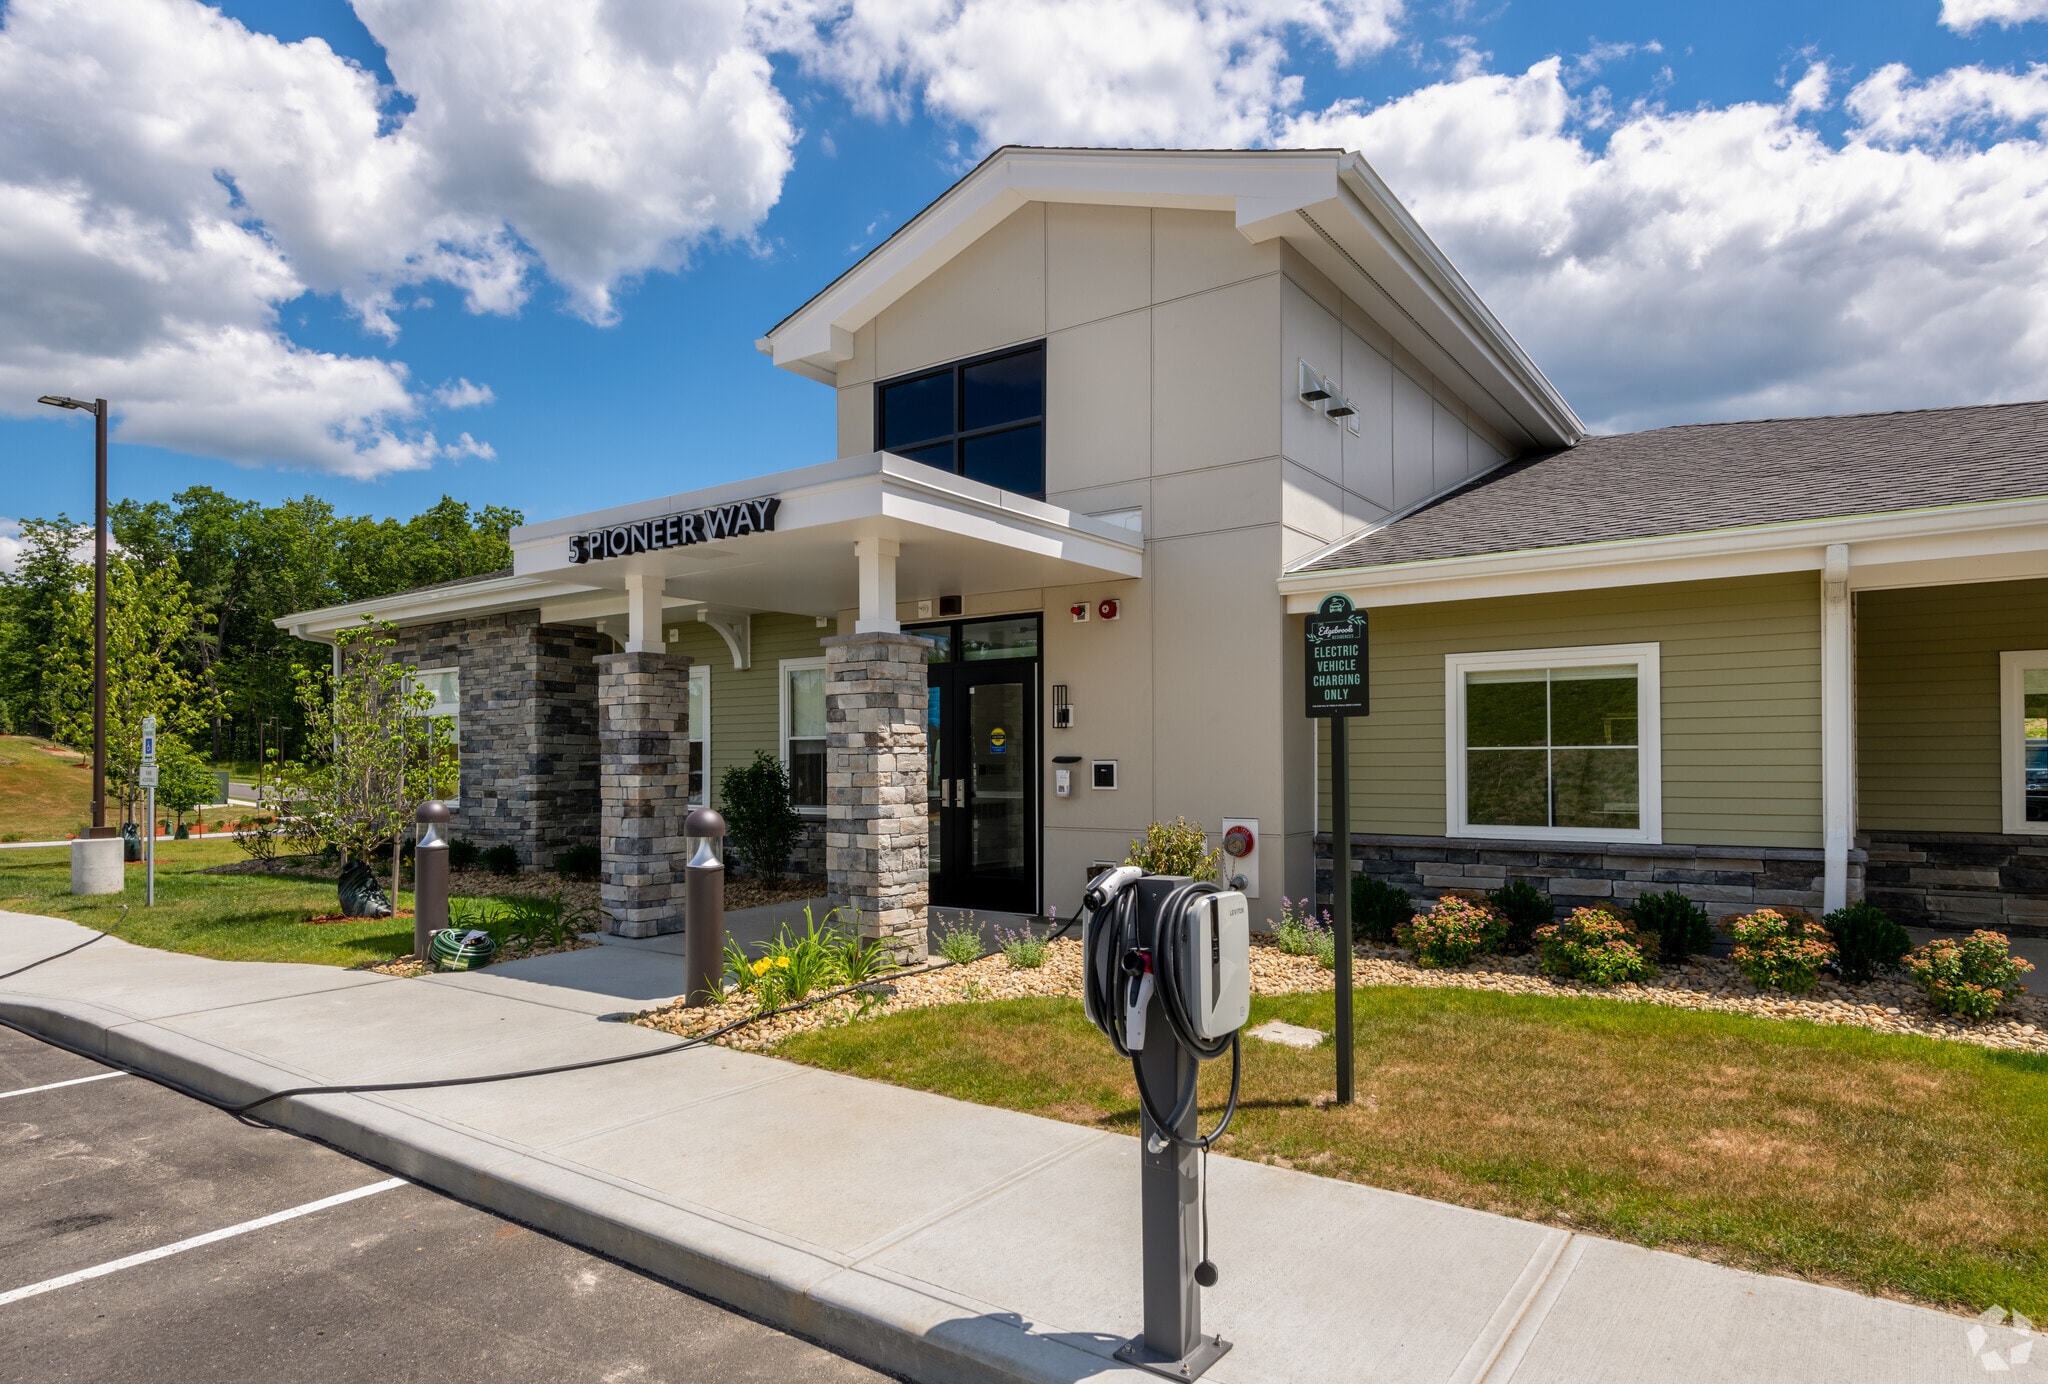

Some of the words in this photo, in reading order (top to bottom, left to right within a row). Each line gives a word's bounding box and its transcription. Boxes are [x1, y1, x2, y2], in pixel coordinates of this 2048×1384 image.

[569, 535, 588, 564] 5
[588, 514, 707, 560] PIONEER
[704, 498, 782, 539] WAY
[1318, 624, 1354, 638] Edgebrook
[1314, 644, 1359, 658] ELECTRIC
[1317, 659, 1356, 672] VEHICLE
[1313, 673, 1361, 687] CHARGING
[1324, 688, 1349, 700] ONLY
